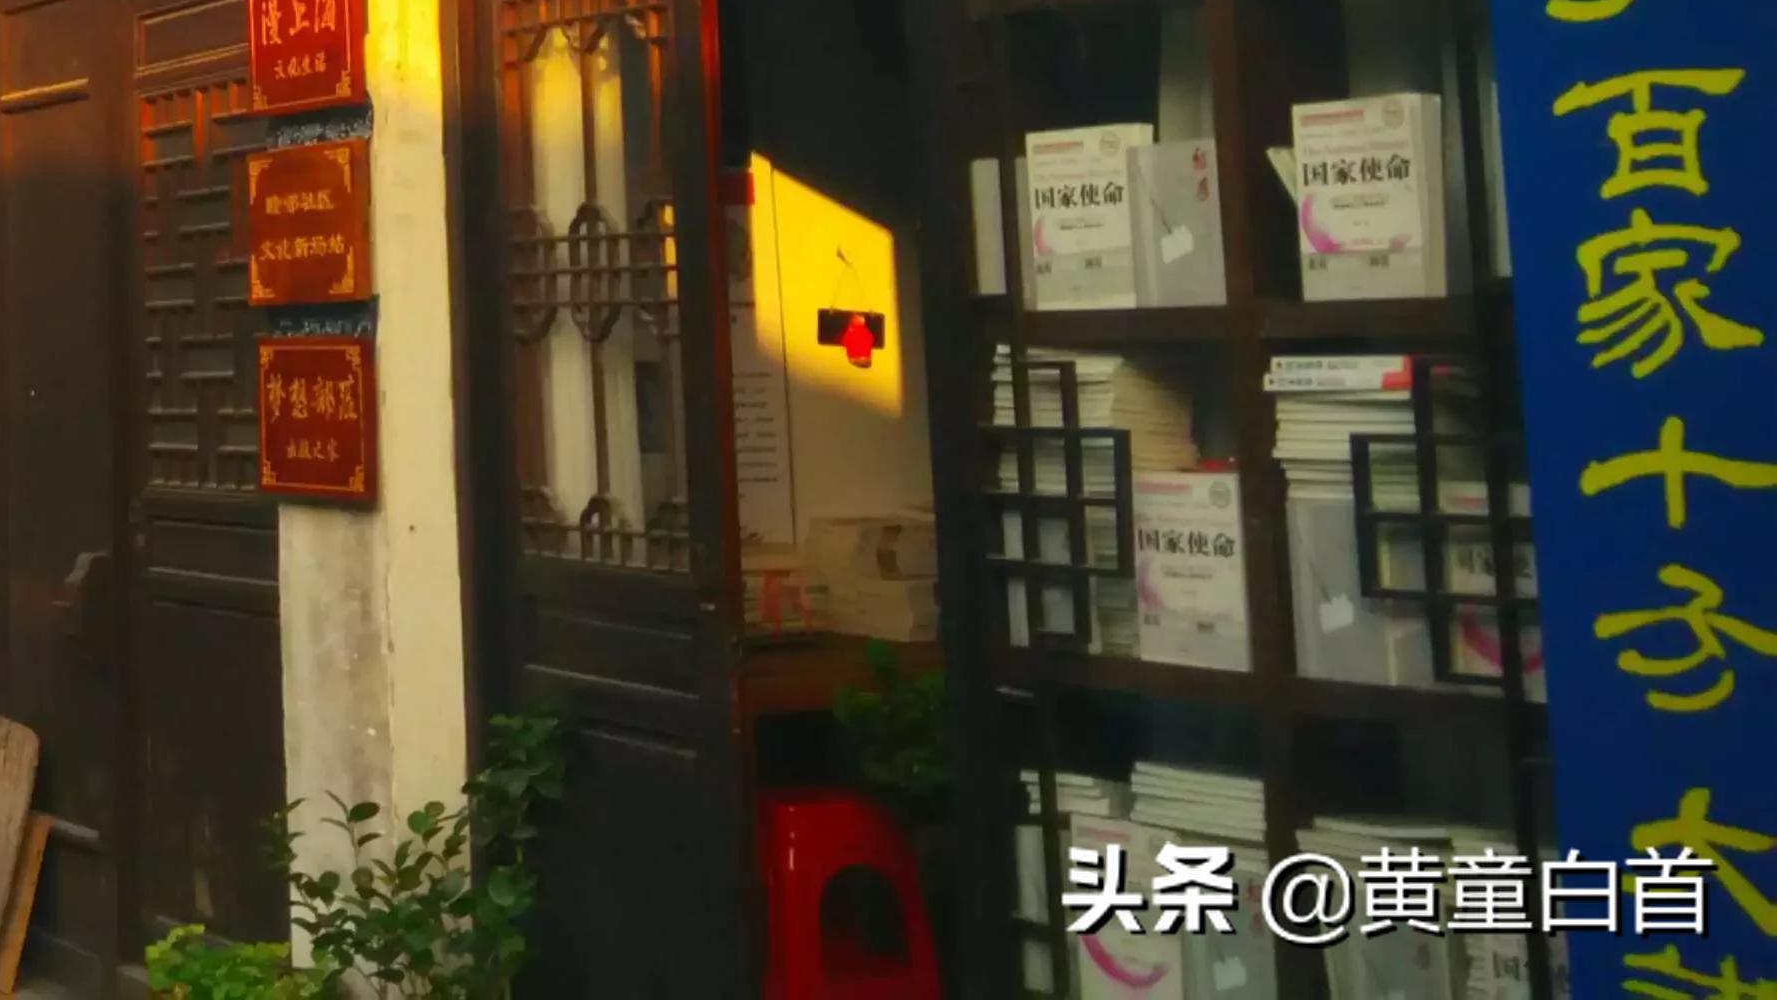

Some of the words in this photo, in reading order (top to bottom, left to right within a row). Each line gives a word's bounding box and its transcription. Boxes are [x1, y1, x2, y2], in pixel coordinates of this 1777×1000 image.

[1302, 153, 1412, 187] 国家使命
[1034, 180, 1125, 209] 国家使命
[1137, 527, 1237, 559] 国家使命
